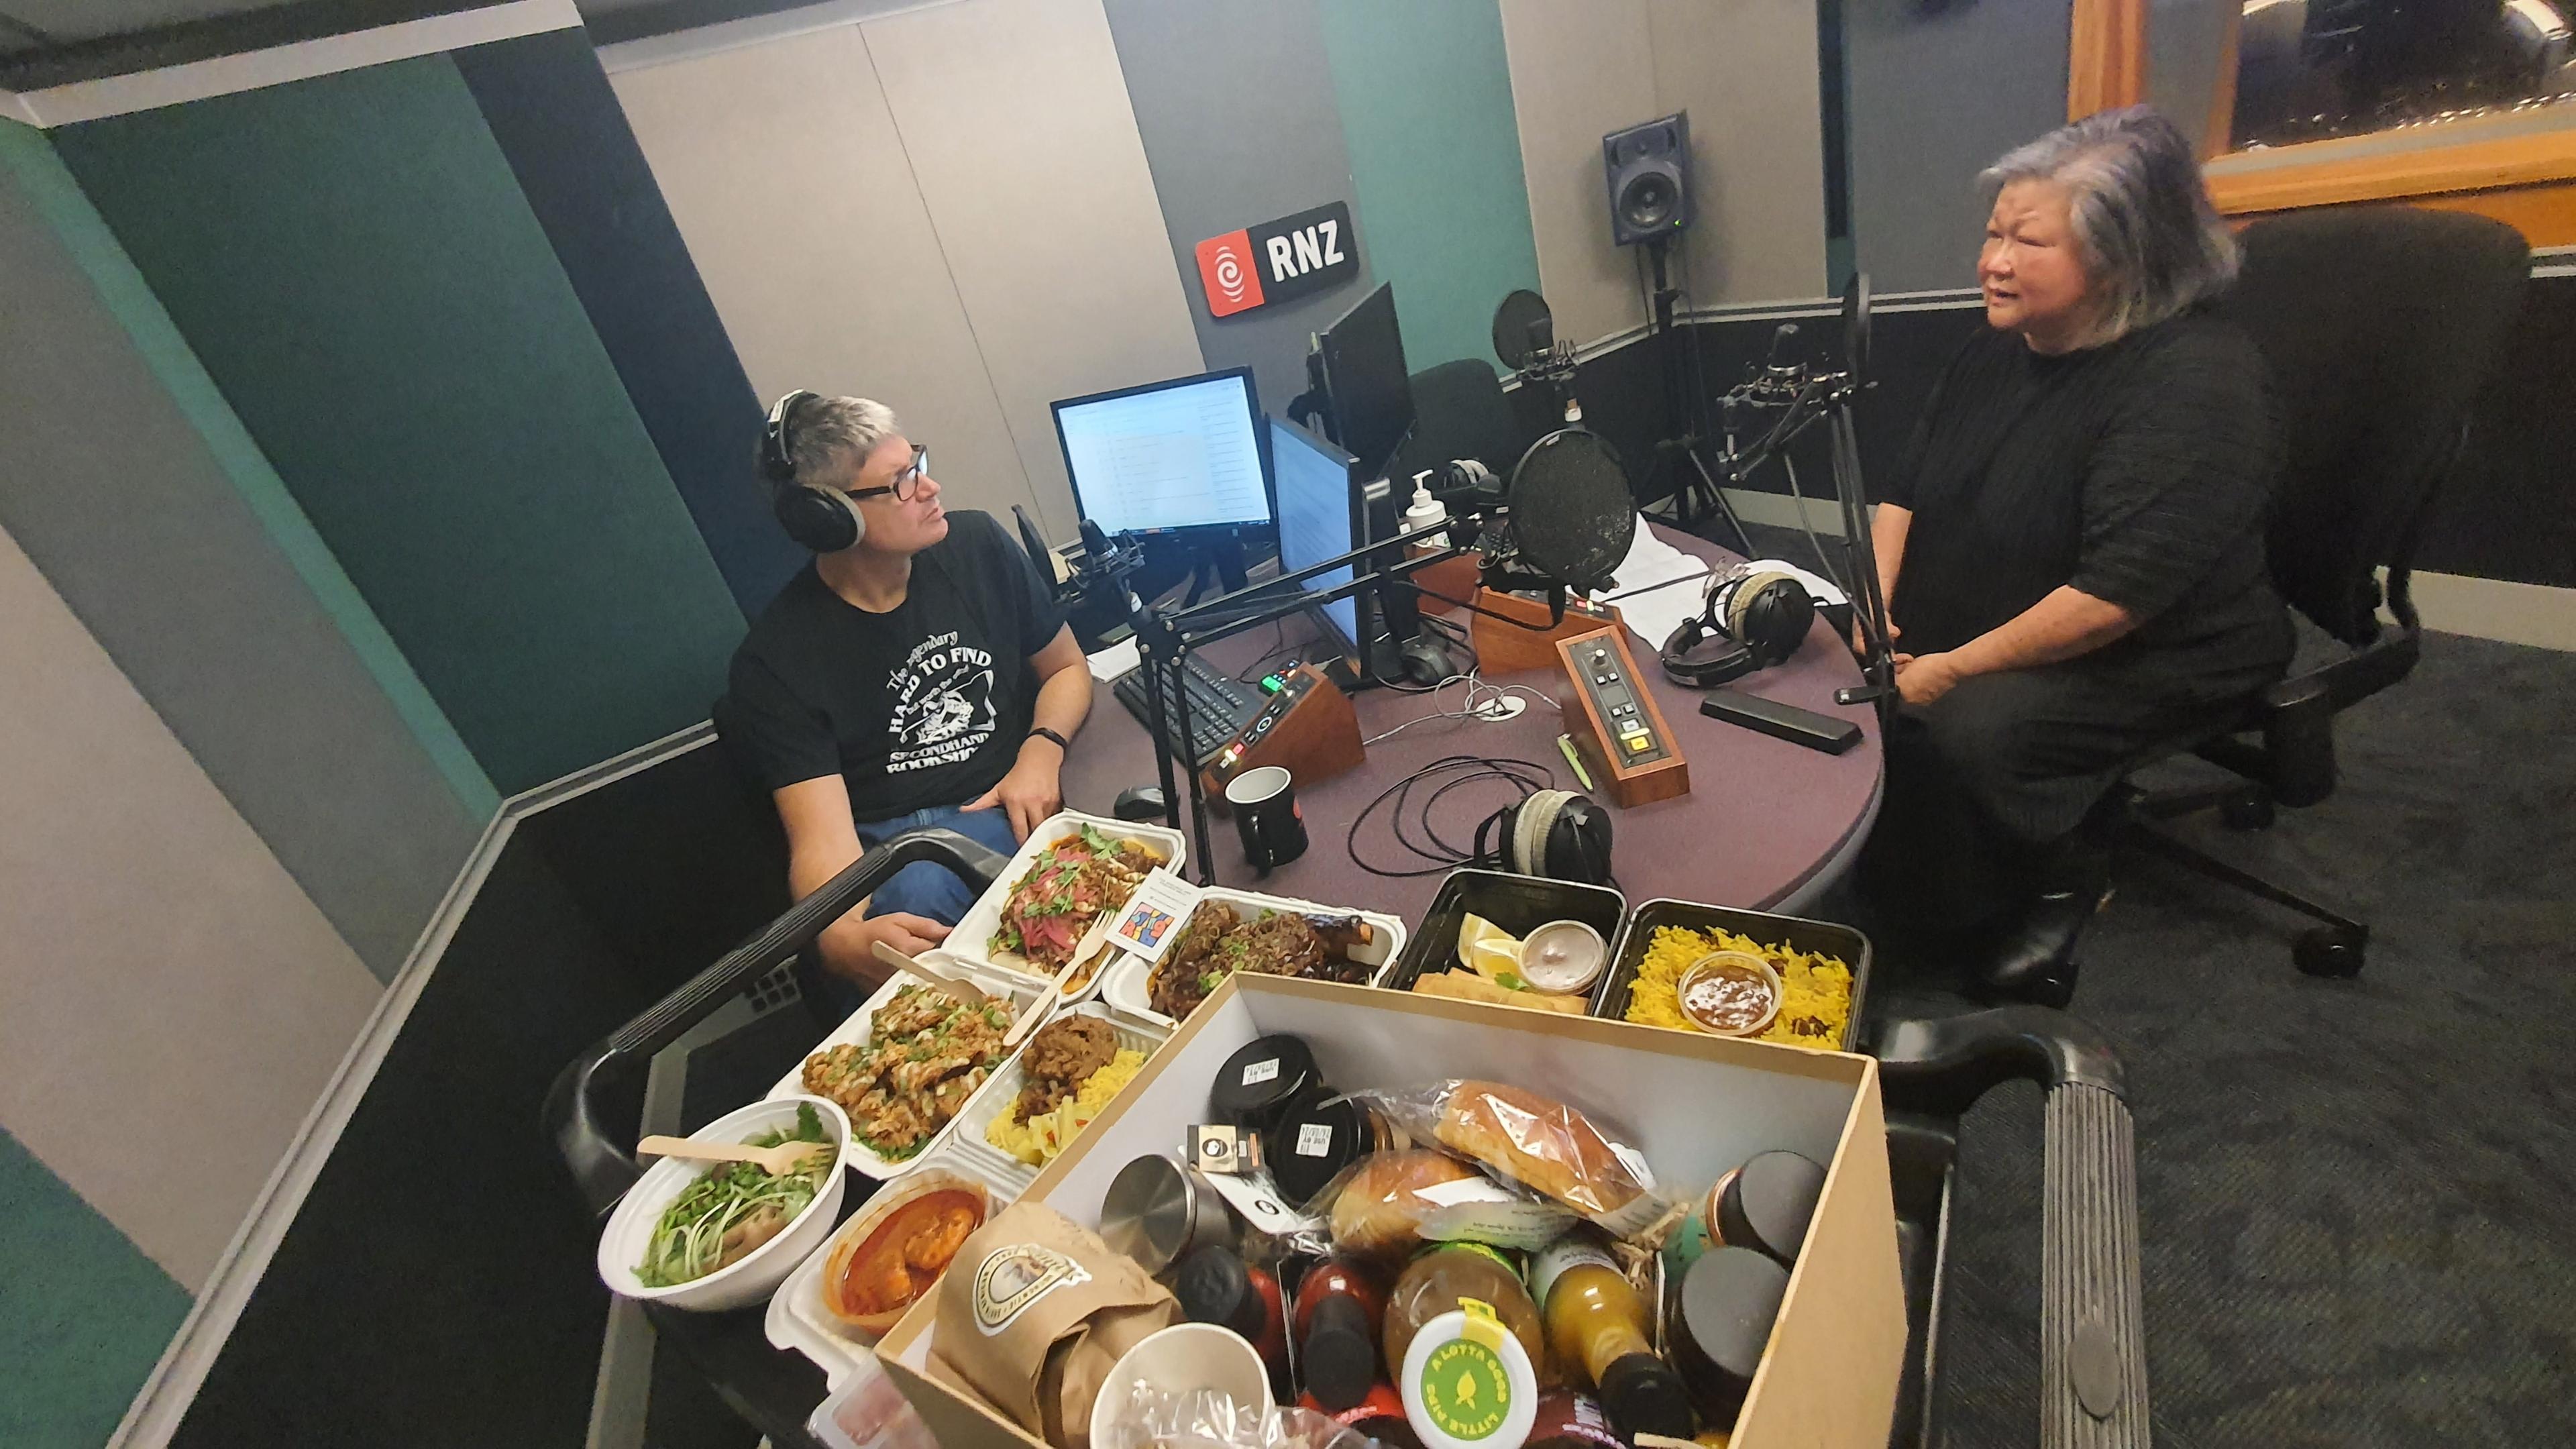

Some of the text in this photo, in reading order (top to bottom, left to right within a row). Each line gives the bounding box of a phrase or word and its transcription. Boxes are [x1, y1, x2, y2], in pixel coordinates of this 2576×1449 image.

[1267, 219, 1344, 282] RNZ
[888, 674, 921, 733] HARD
[918, 653, 947, 676] TO
[950, 647, 992, 667] FIND
[1432, 1358, 1442, 1371] A
[1441, 1344, 1485, 1362] LOTTA
[1449, 1411, 1499, 1435] LITTLE
